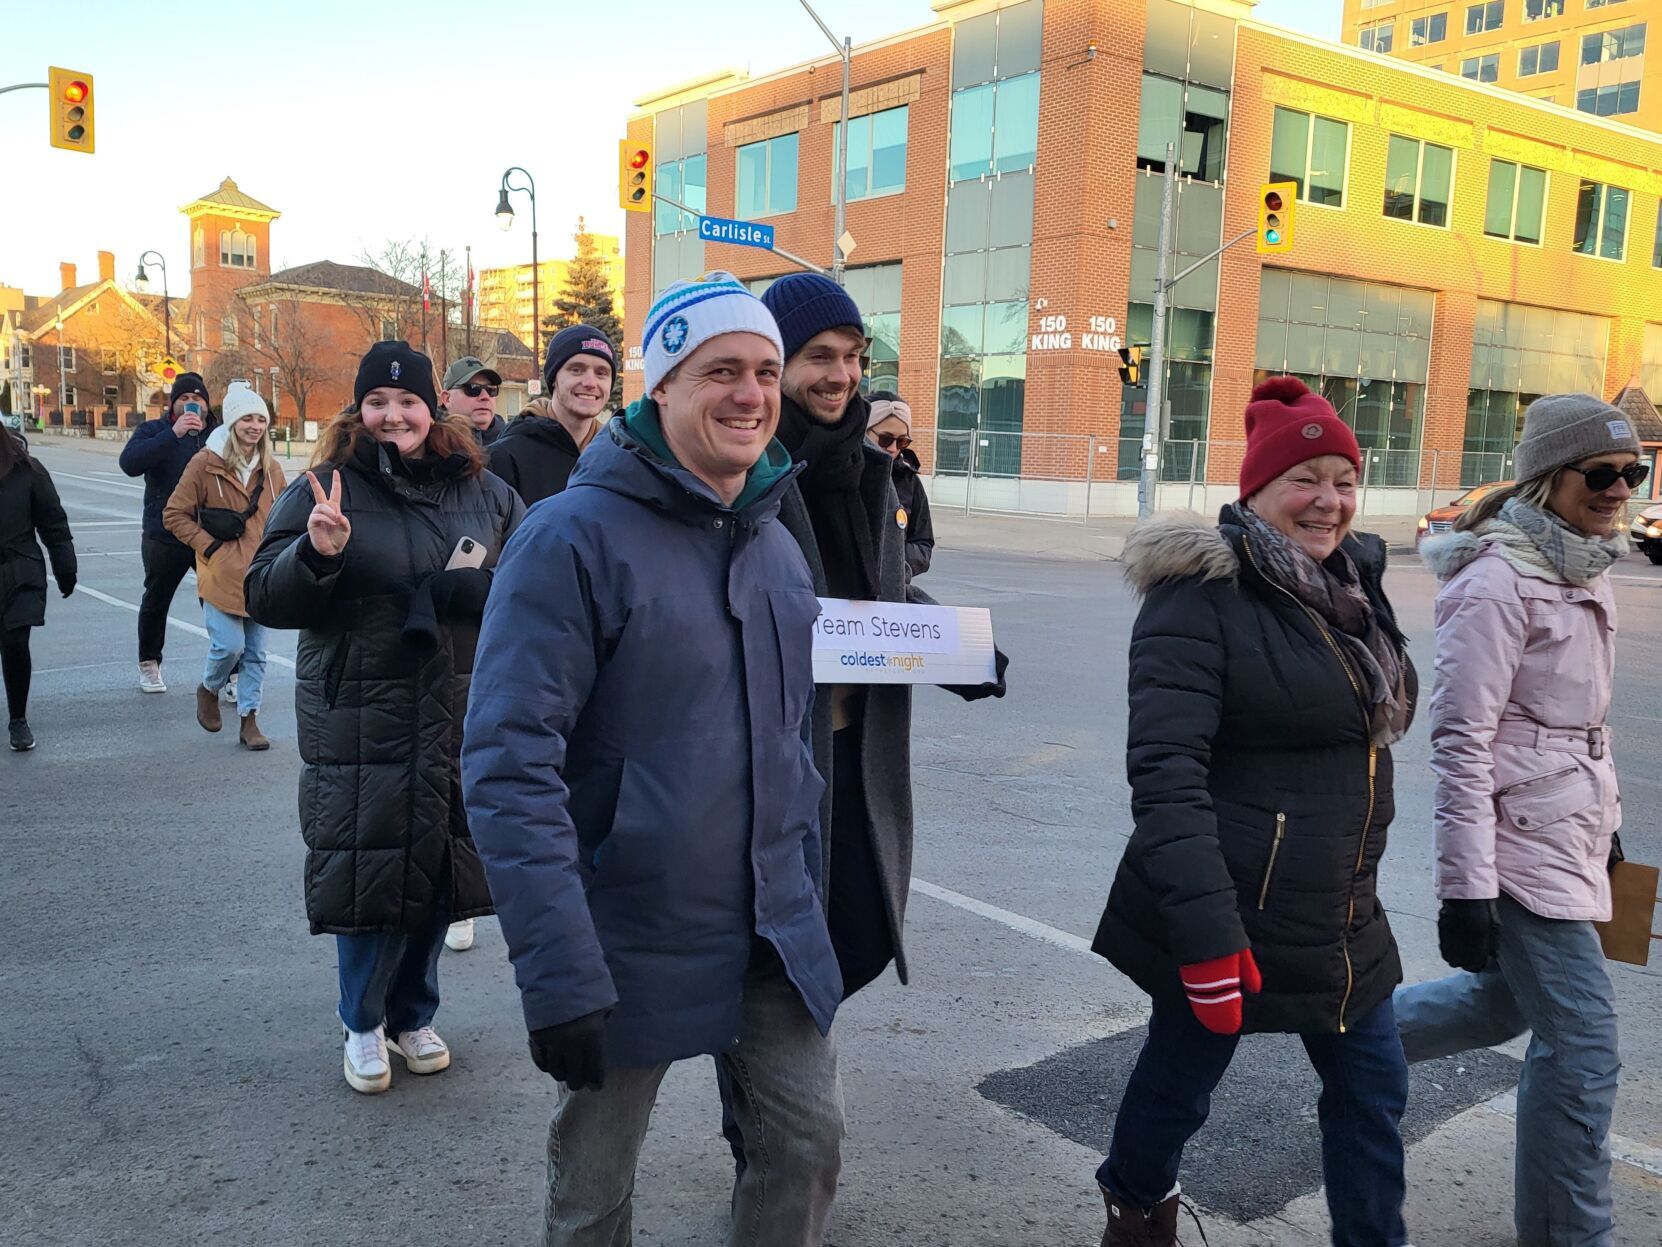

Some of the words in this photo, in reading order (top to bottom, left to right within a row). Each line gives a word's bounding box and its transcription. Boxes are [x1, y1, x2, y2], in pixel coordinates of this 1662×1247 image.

[701, 219, 762, 242] Carlisle
[1039, 315, 1067, 332] 150
[1089, 315, 1116, 333] 150
[1031, 332, 1072, 350] KING
[1081, 333, 1121, 352] KING
[629, 345, 643, 358] 150
[815, 613, 865, 637] Team
[871, 616, 941, 640] Stevens
[840, 651, 887, 667] coldest
[892, 653, 925, 672] night
